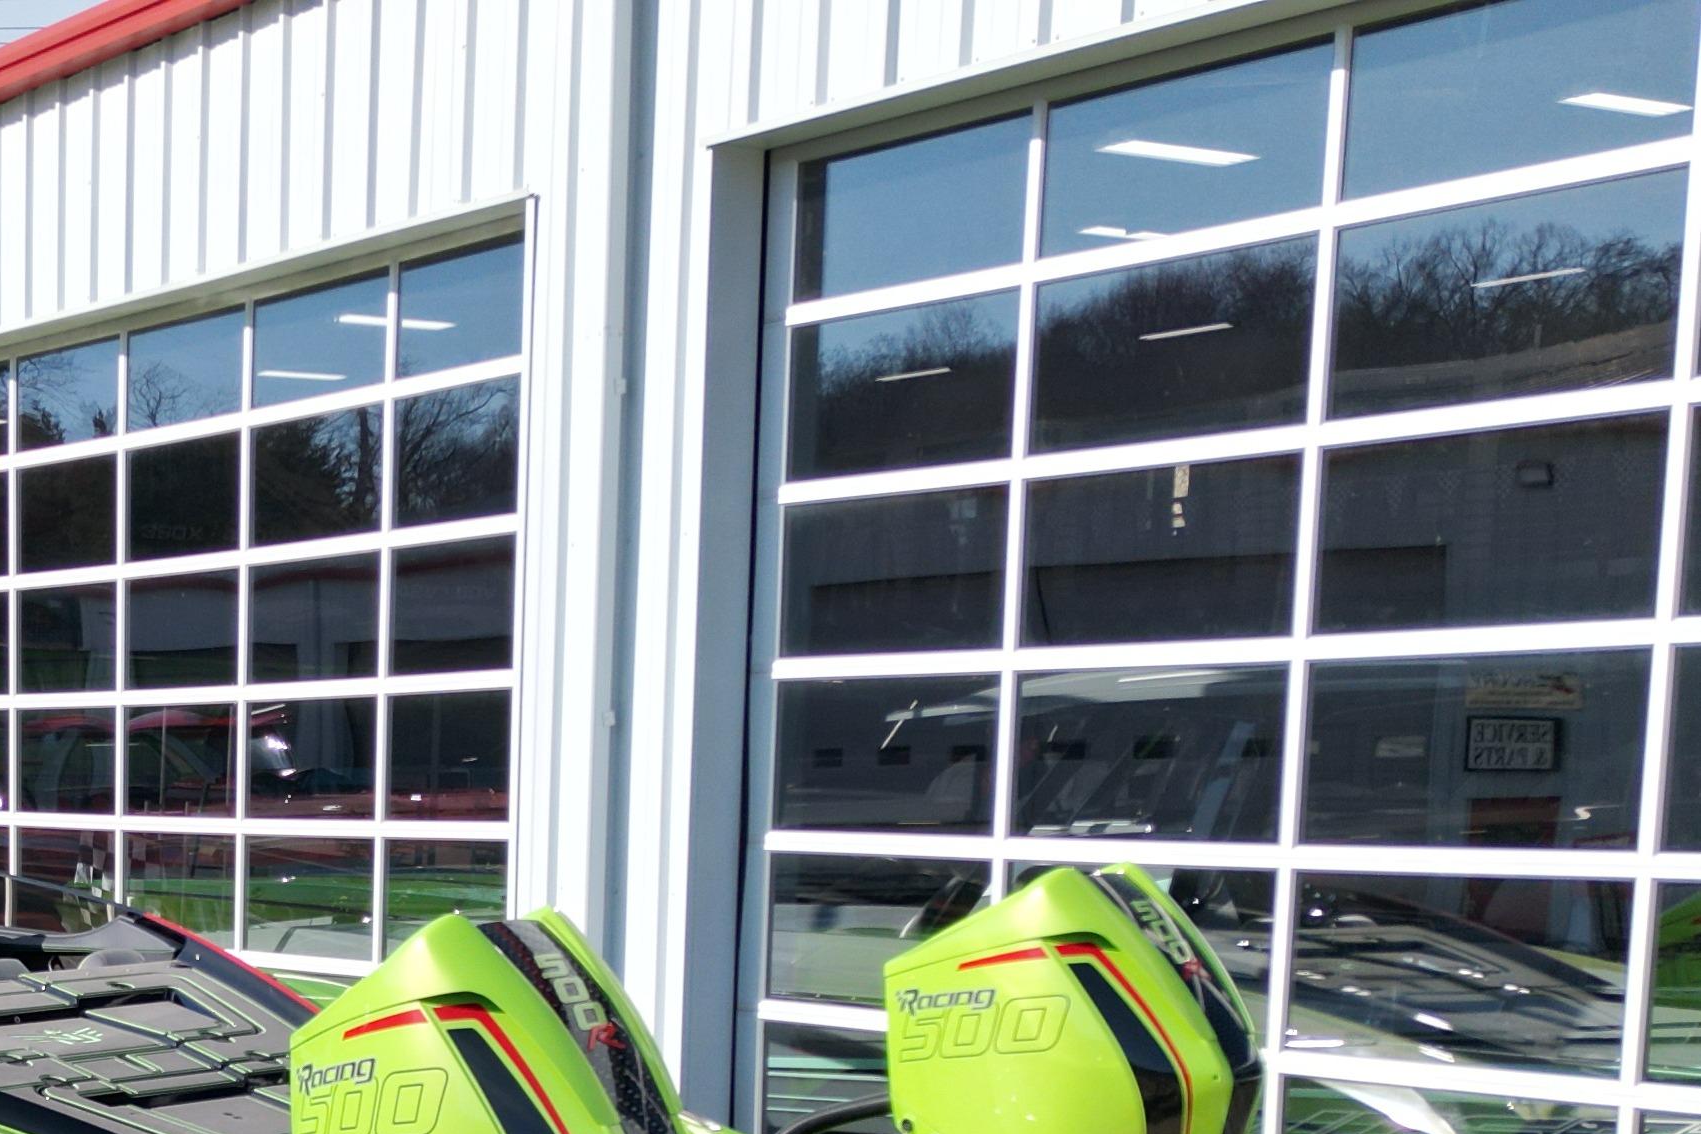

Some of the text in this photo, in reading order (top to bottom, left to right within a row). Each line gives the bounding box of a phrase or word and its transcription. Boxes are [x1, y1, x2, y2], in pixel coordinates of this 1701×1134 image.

[896, 988, 995, 1016] Racing
[899, 995, 1071, 1063] 500
[297, 1058, 375, 1095] Racing
